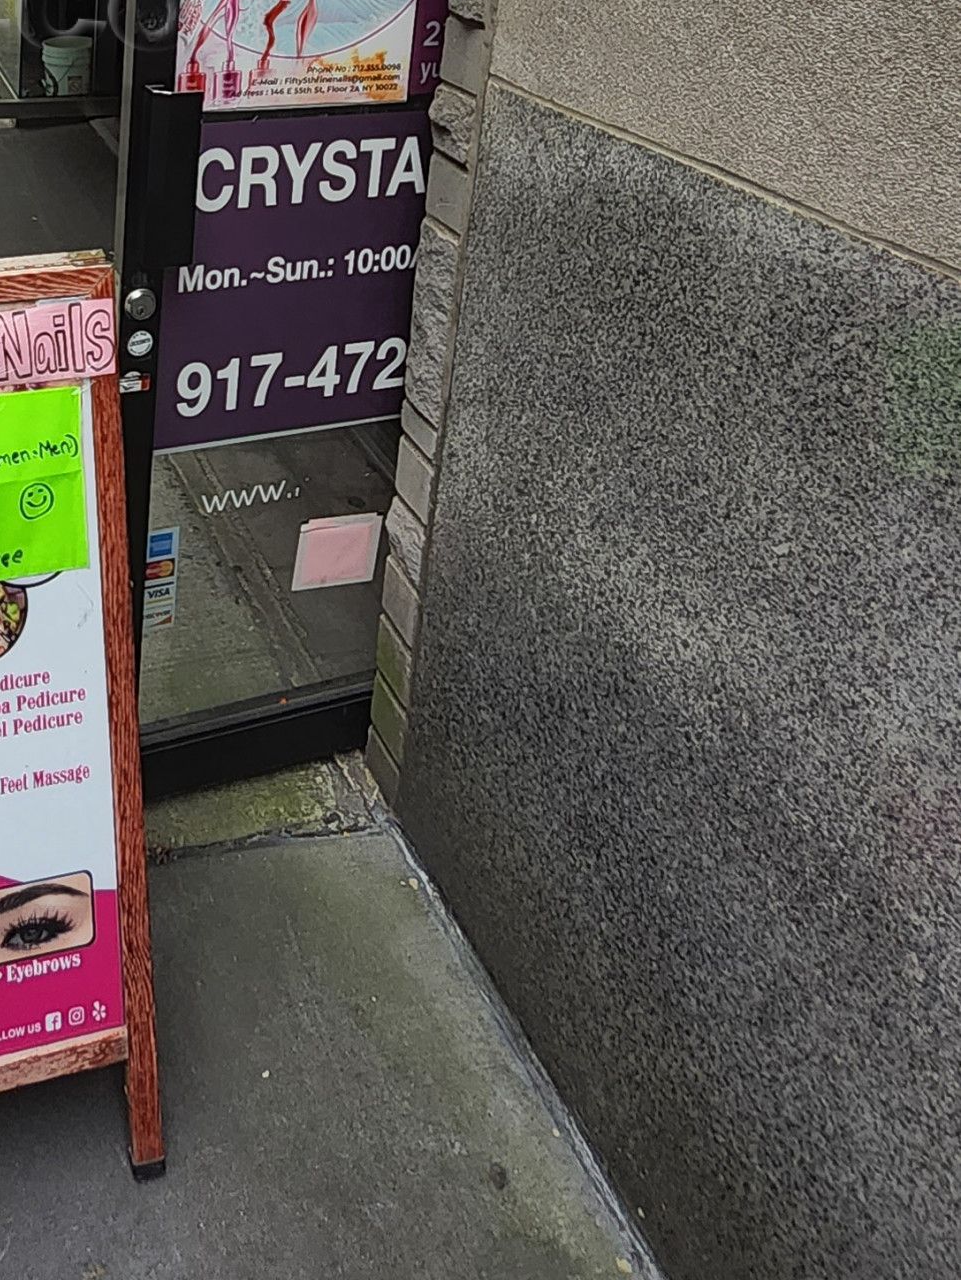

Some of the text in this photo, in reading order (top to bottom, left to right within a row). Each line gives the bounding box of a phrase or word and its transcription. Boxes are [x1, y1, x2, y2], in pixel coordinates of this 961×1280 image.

[362, 84, 374, 92] NY
[178, 255, 335, 294] Mon.~Sun.:
[148, 587, 170, 599] VISA
[16, 685, 87, 712] Pedicure
[17, 709, 84, 736] Pedicure
[33, 764, 91, 790] Massage
[5, 951, 82, 987] Eyebrows
[28, 1022, 42, 1037] US
